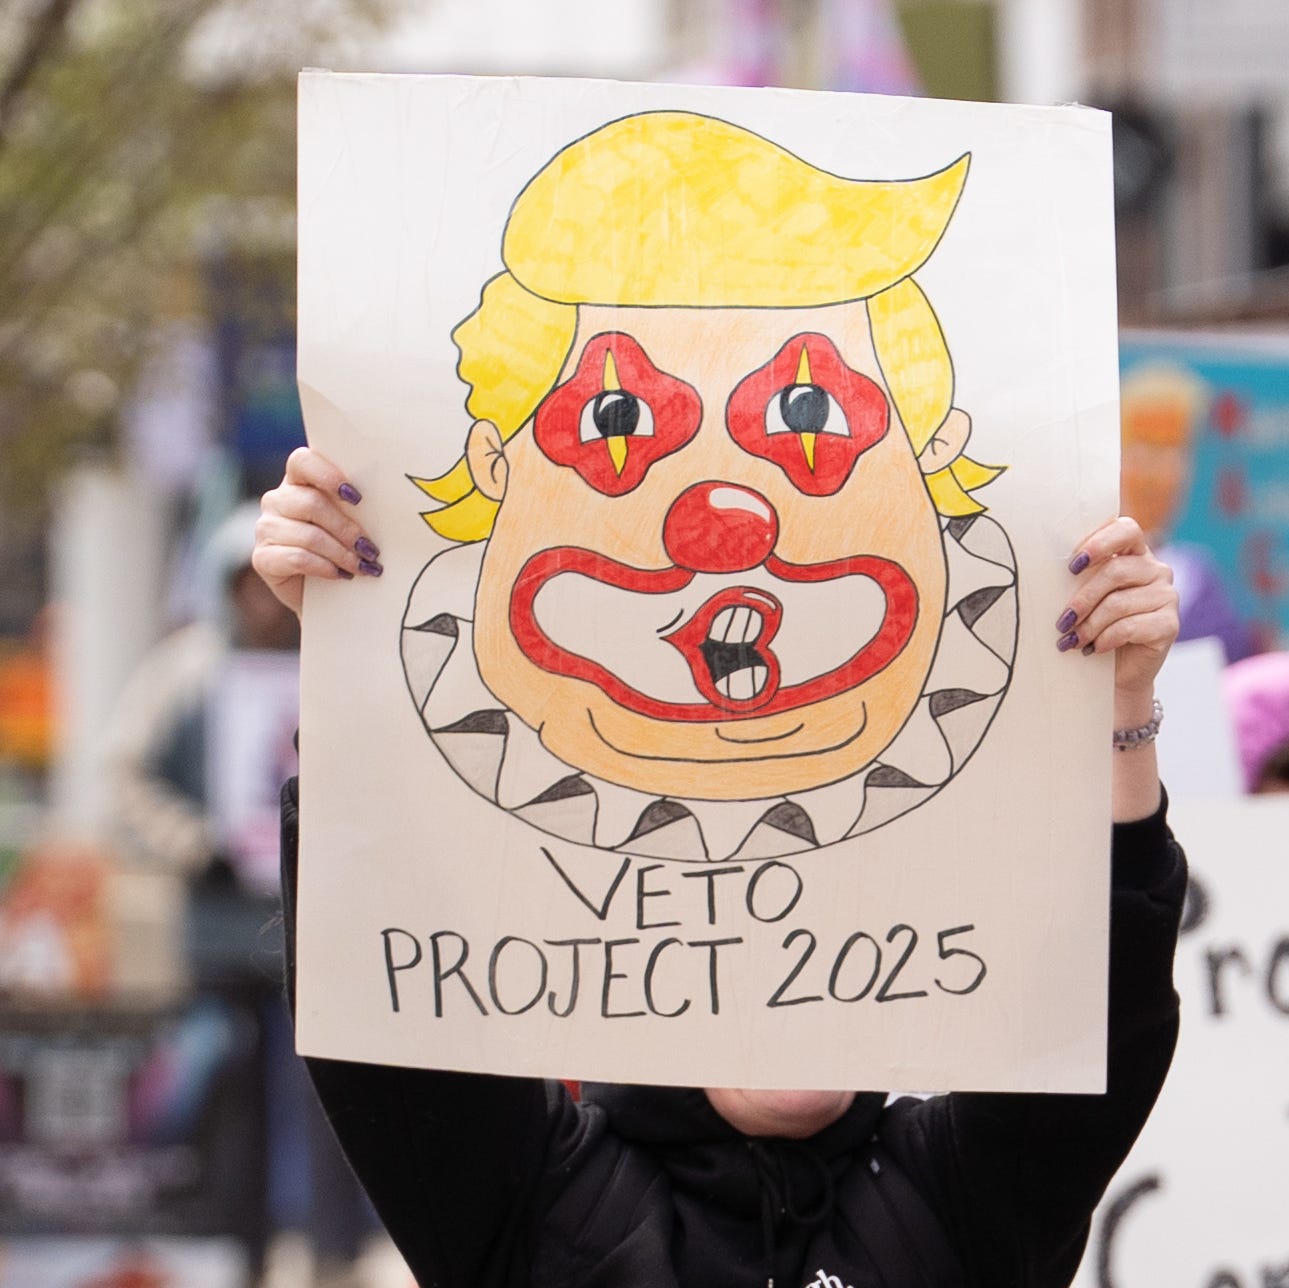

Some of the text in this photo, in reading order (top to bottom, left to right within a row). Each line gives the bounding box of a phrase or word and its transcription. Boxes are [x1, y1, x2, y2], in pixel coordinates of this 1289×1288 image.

[540, 846, 803, 930] VETO
[381, 924, 987, 1019] PROJECT 2025
